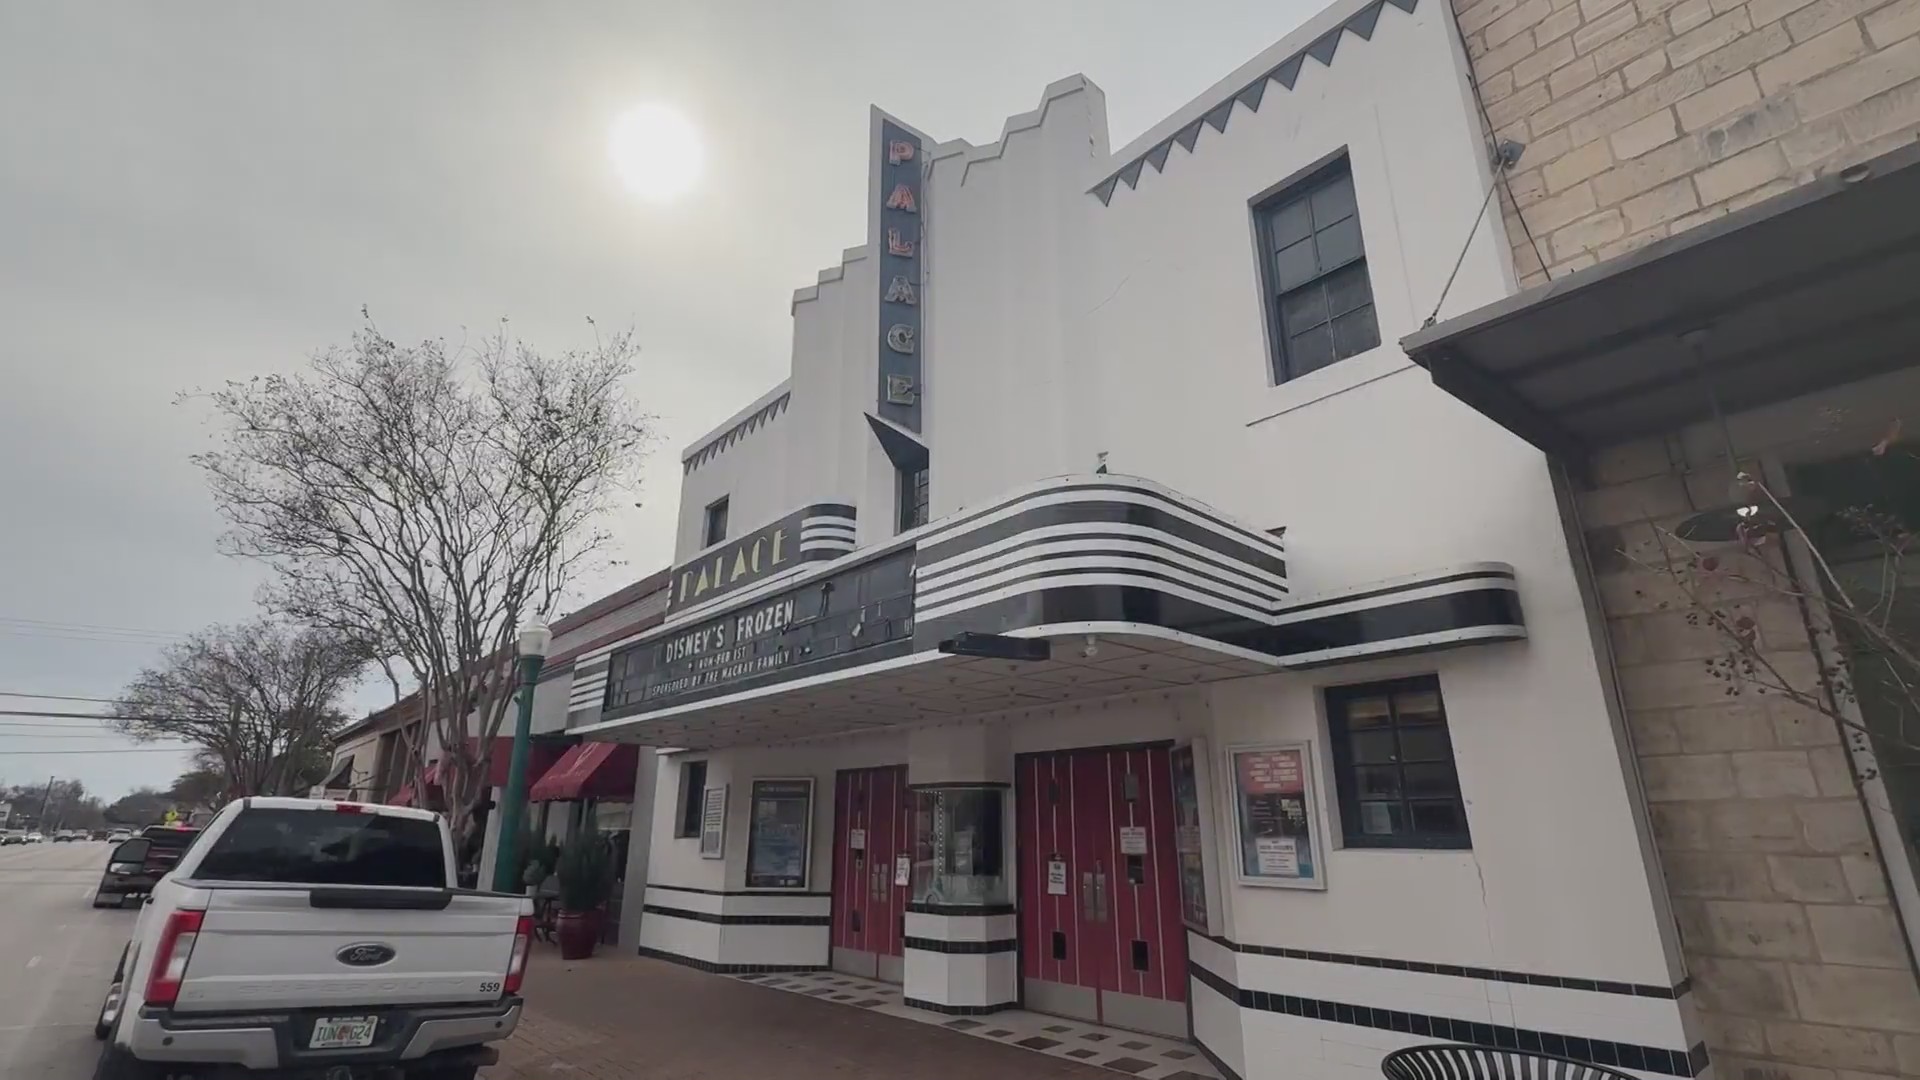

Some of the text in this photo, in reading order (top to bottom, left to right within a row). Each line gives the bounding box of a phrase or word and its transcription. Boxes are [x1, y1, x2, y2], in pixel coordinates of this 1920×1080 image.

[885, 139, 917, 406] PALACE
[680, 527, 788, 603] PALACE
[666, 599, 794, 663] DISNEY'S FROZEN
[651, 678, 689, 696] SPONSORED
[692, 674, 702, 687] BY
[704, 671, 719, 683] THE
[757, 650, 790, 669] FAMILY
[479, 982, 500, 993] 559
